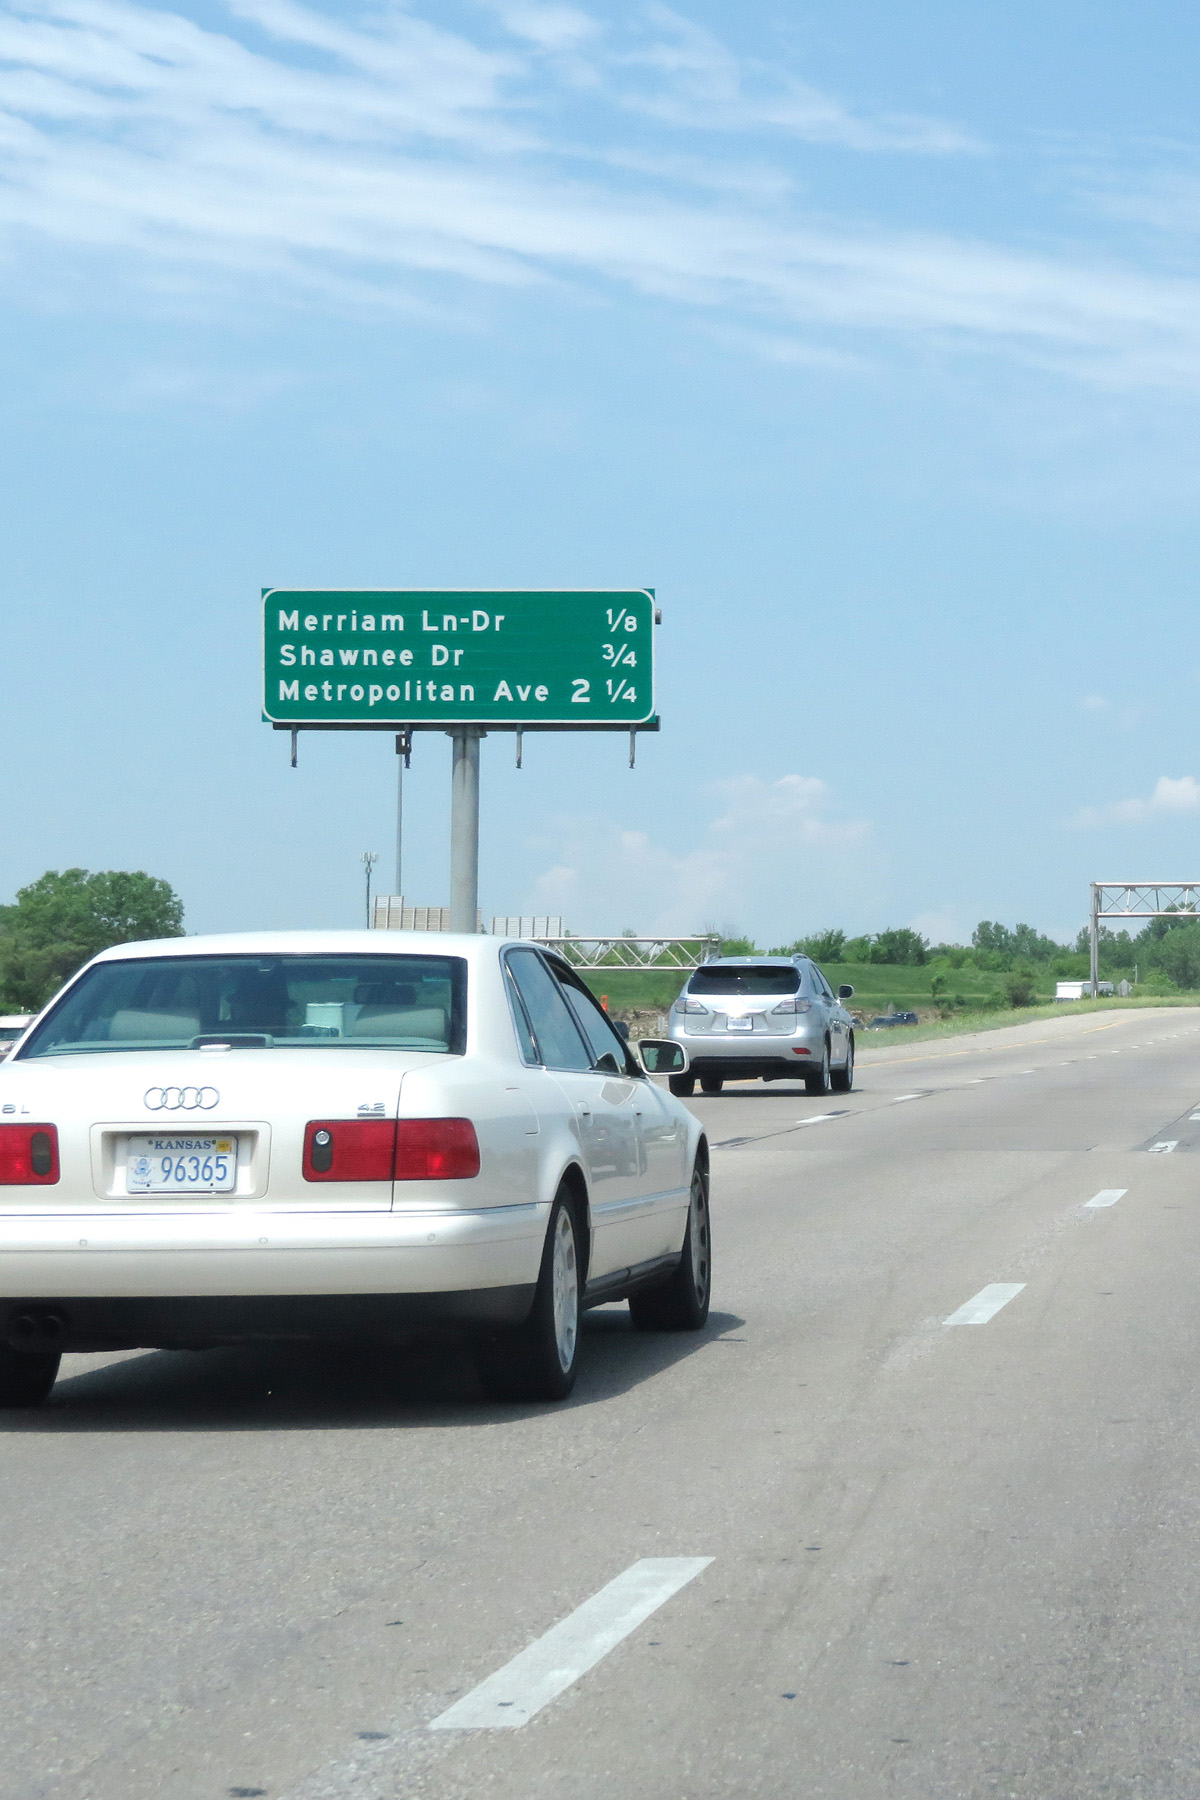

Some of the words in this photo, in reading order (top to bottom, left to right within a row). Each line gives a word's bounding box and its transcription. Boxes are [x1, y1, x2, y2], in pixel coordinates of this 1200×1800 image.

[278, 610, 405, 632] Merriam
[422, 610, 506, 632] Ln-Dr
[279, 644, 414, 666] Shawnee
[431, 645, 465, 666] Dr
[278, 679, 476, 706] Metropolitan
[493, 680, 549, 702] Ave
[570, 678, 591, 703] 2
[357, 1102, 386, 1111] 4.2
[154, 1140, 212, 1150] KANSAS
[161, 1155, 228, 1182] 96365
